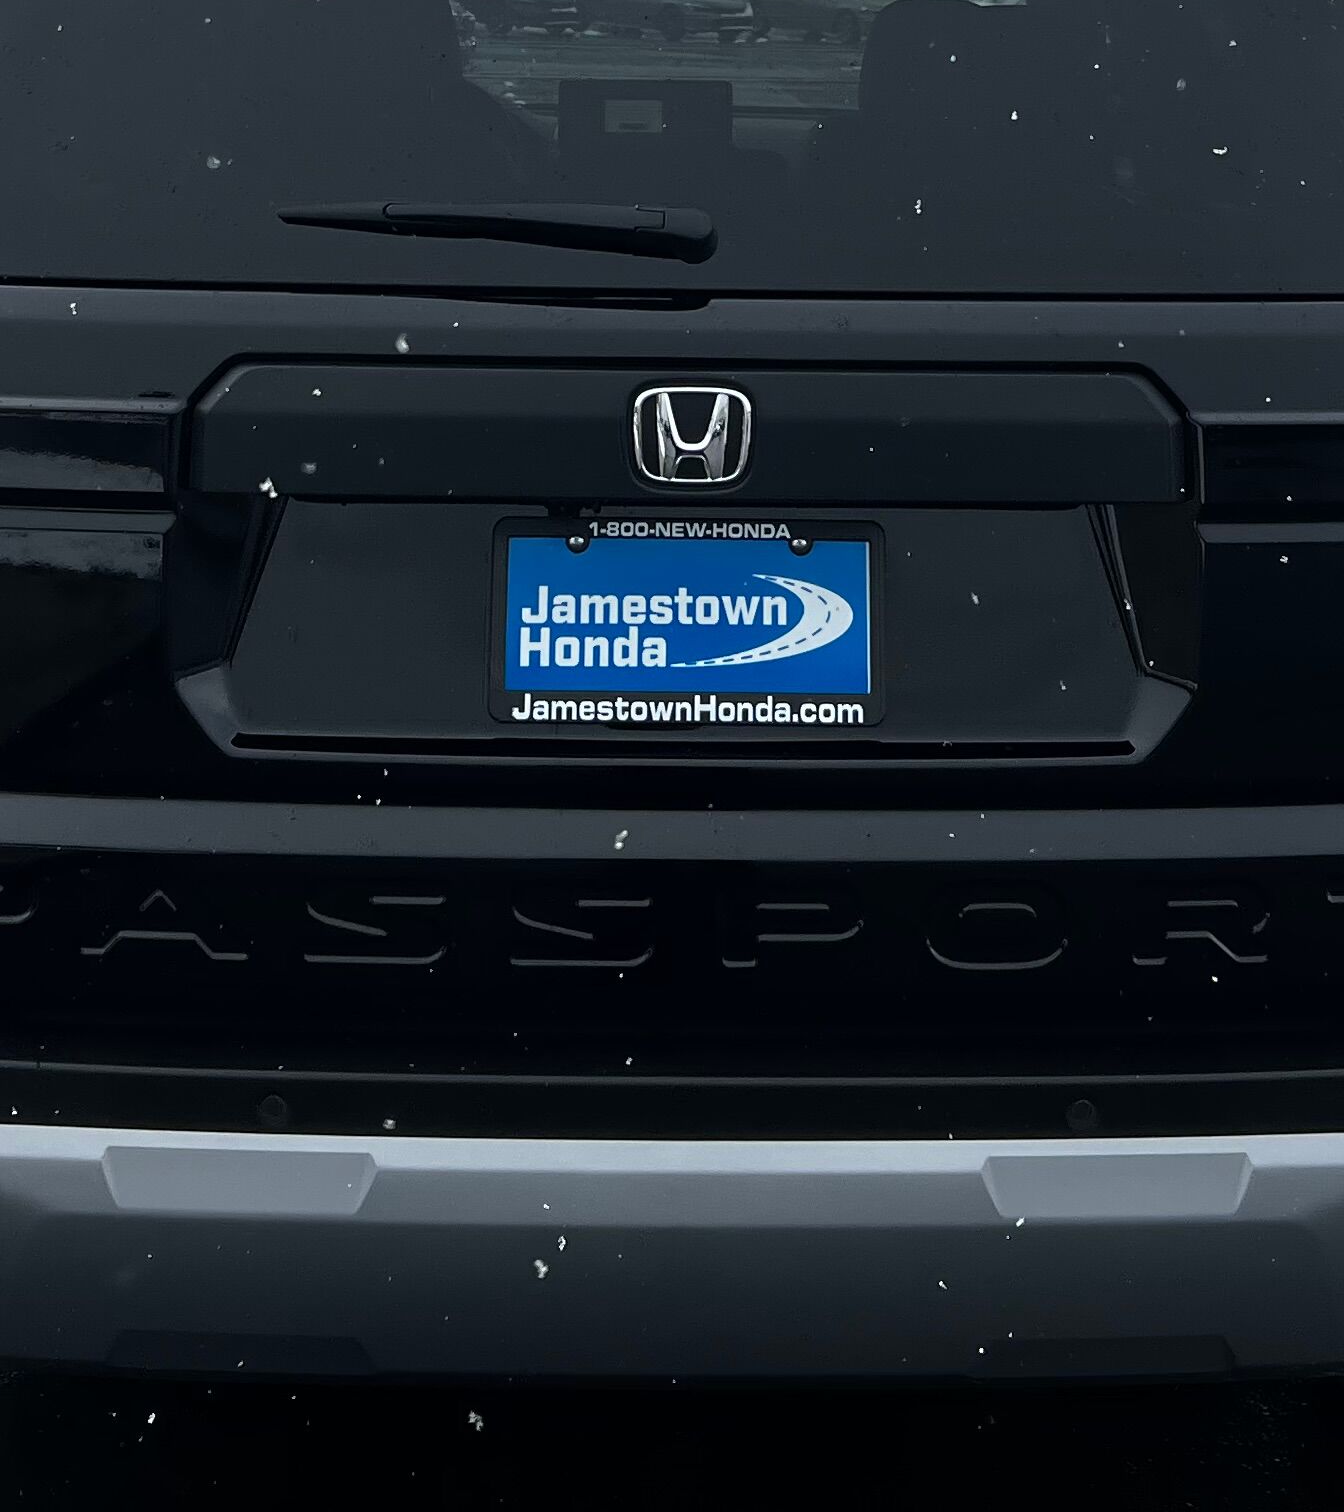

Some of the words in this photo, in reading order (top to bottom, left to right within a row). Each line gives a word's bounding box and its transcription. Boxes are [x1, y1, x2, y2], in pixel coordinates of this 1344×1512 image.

[588, 521, 792, 539] 1-800-NEW-HONDA
[520, 584, 788, 626] Jamestown
[518, 626, 668, 668] Honda
[511, 693, 865, 725] JamestownHonda.com
